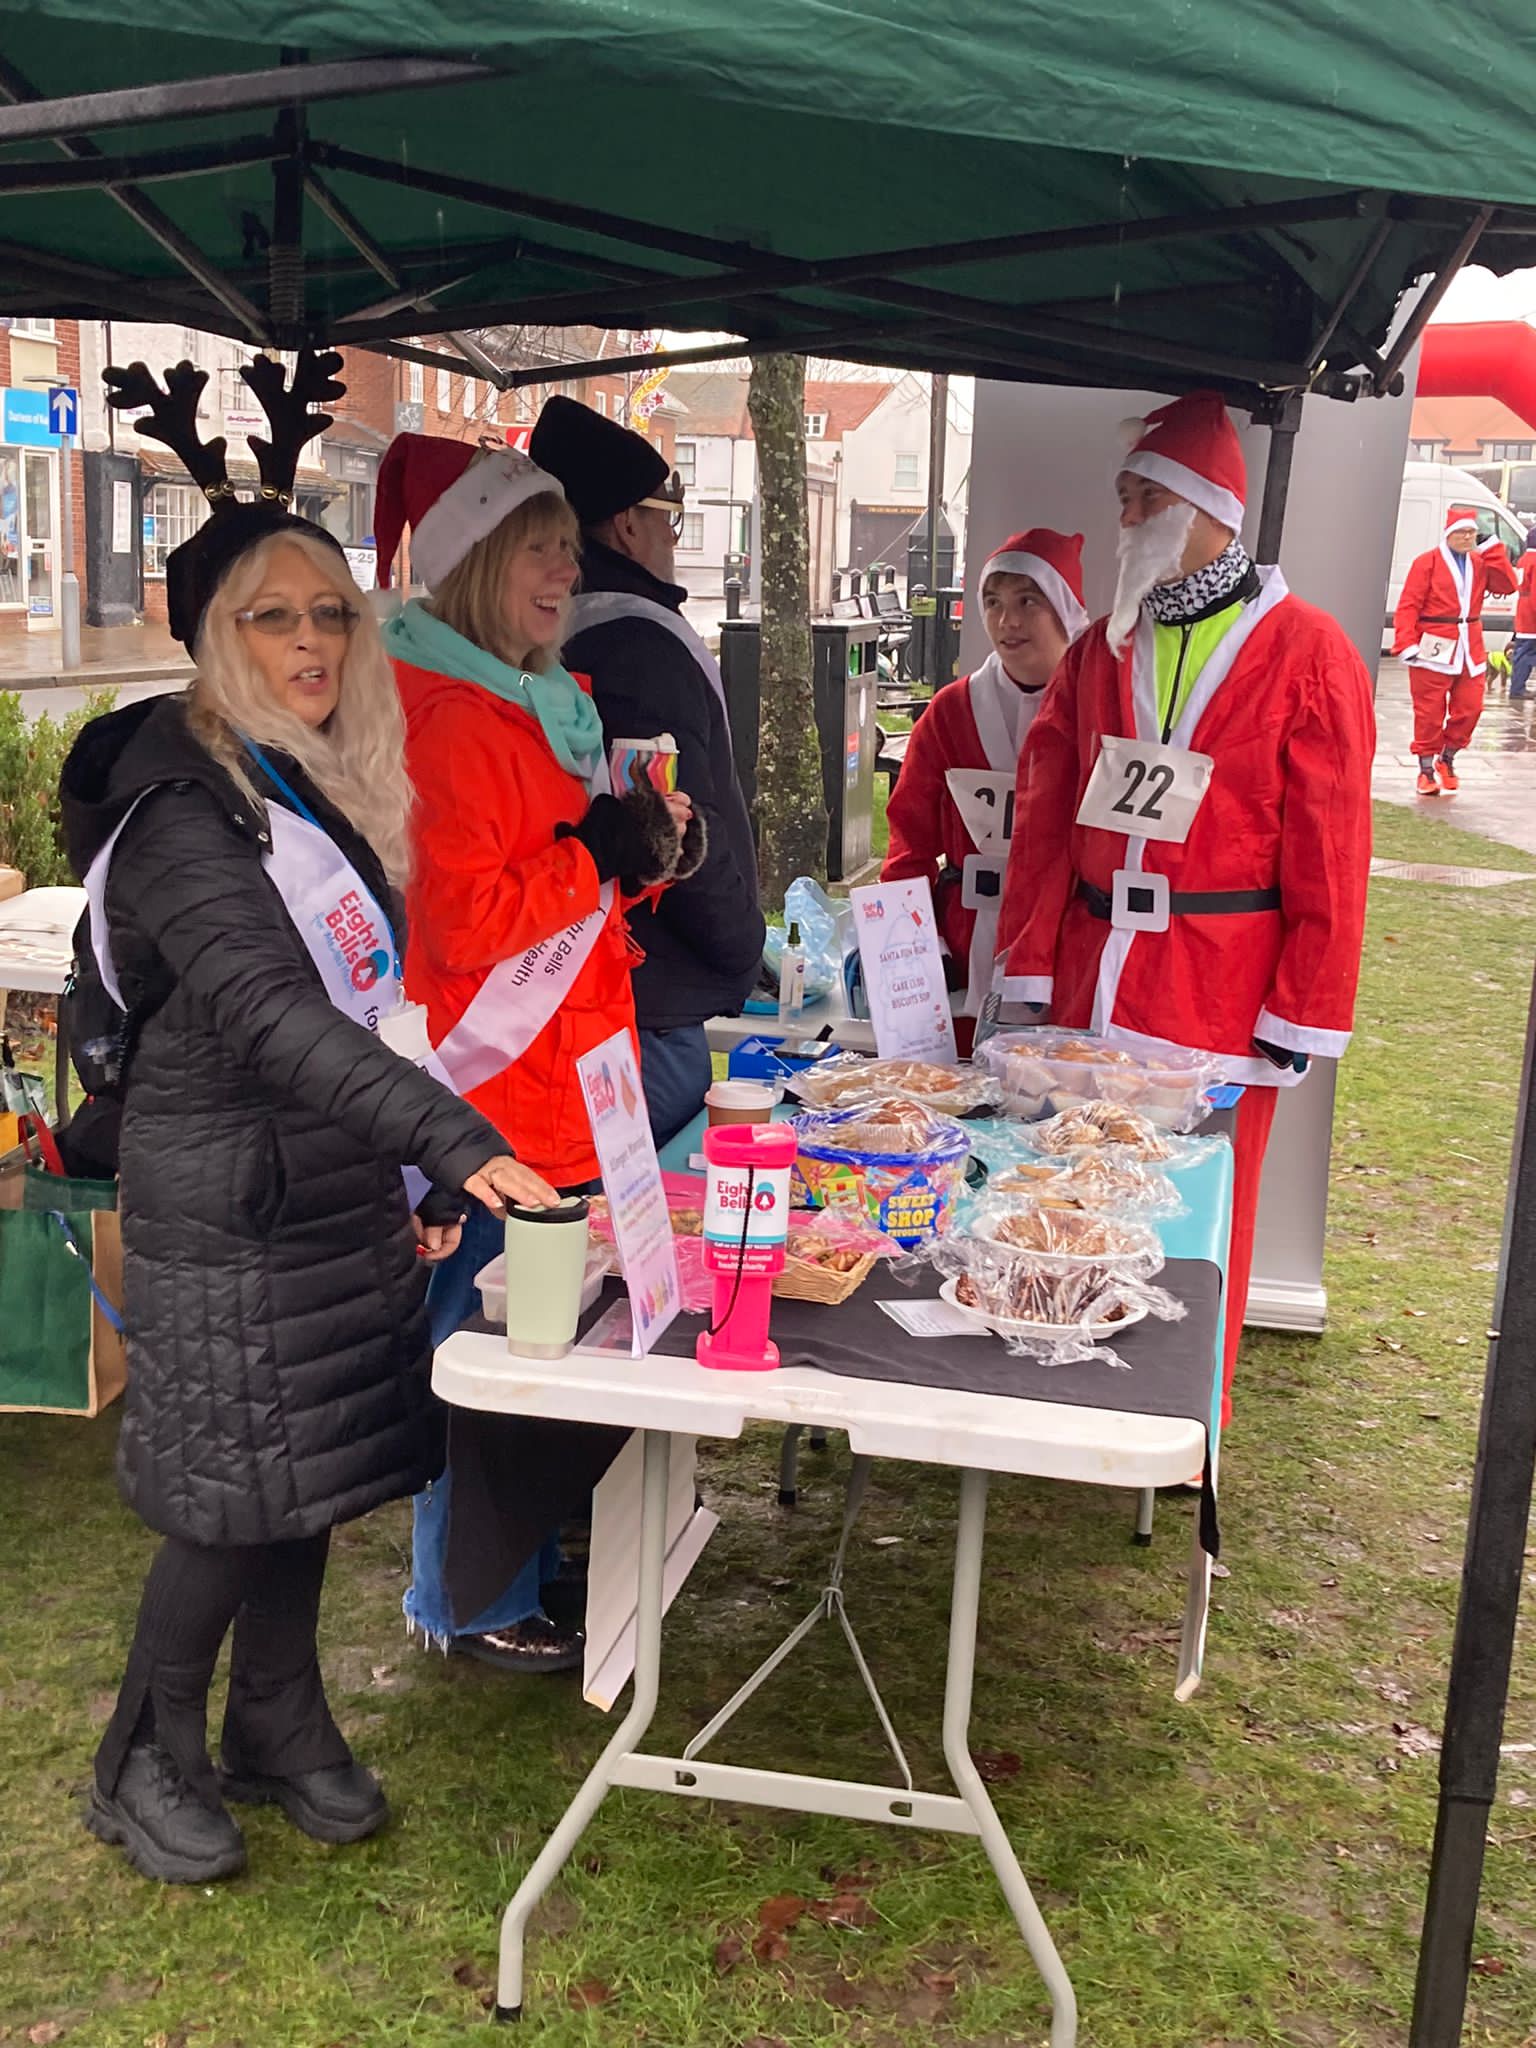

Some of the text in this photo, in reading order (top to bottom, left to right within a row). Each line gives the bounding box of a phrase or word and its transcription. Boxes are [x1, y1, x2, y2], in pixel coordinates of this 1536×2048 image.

[1431, 642, 1442, 657] 5
[1112, 760, 1174, 820] 22
[325, 909, 359, 966] Bells
[339, 890, 380, 951] Eight
[511, 942, 549, 987] Health
[544, 940, 572, 976] Bells
[888, 1193, 937, 1208] SWEET
[888, 1208, 935, 1228] SHOP
